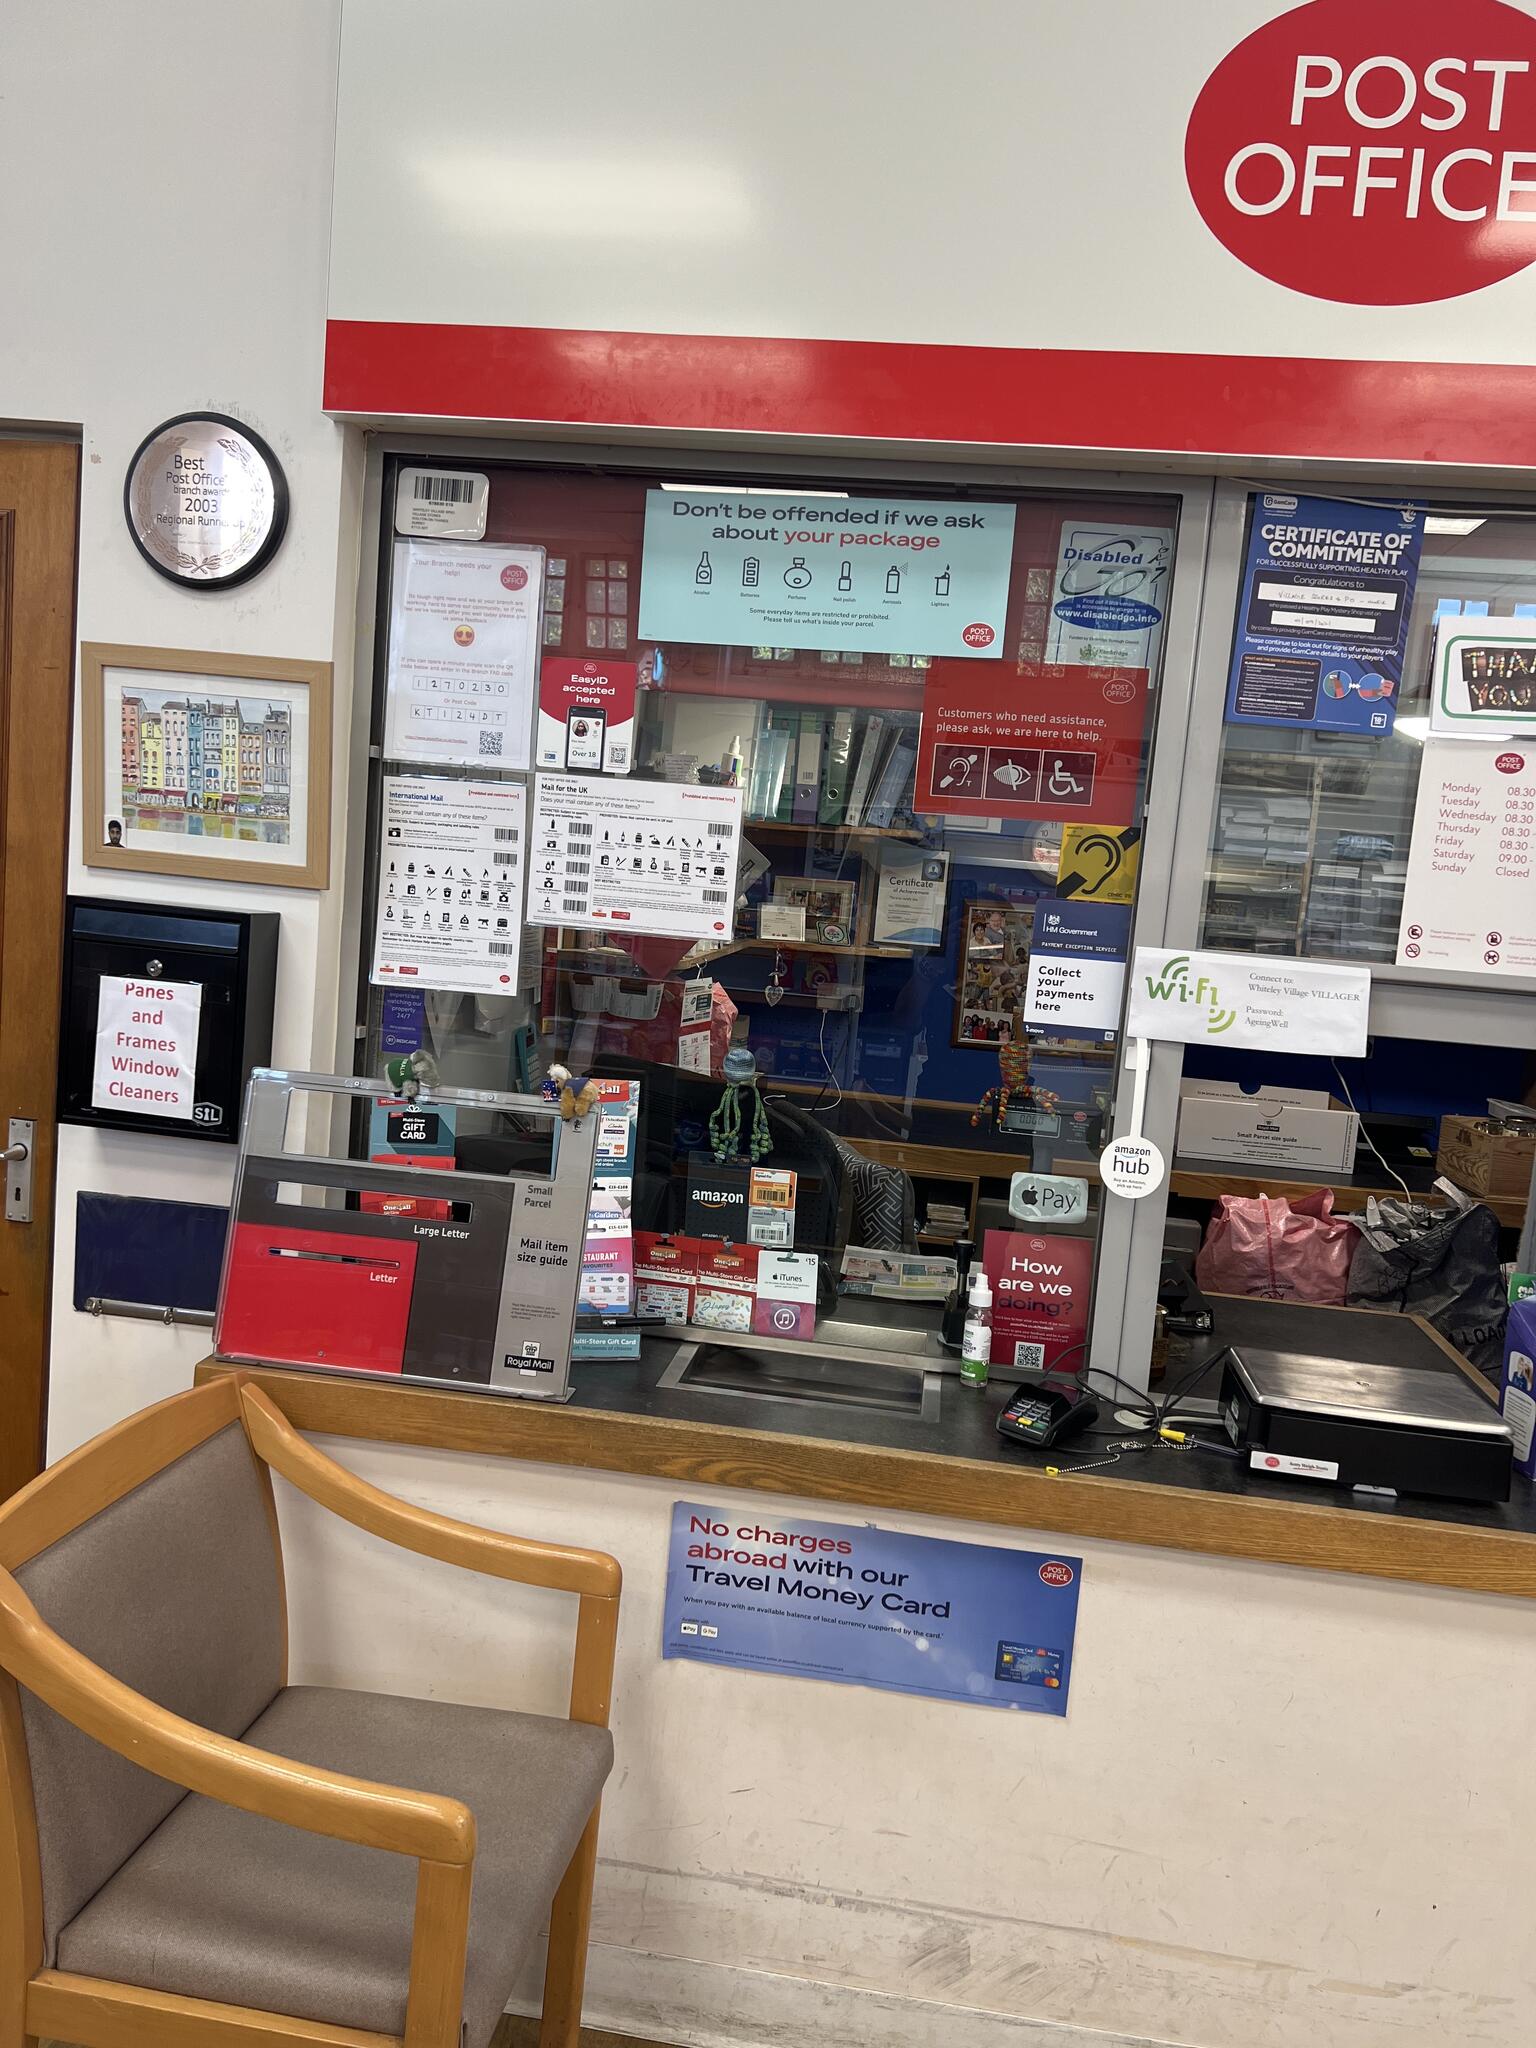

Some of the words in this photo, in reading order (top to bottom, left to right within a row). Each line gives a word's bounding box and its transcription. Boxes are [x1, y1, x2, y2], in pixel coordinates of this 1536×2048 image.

[1290, 55, 1529, 131] POST
[1224, 142, 1536, 222] OFFICE
[174, 454, 205, 470] Best
[166, 472, 189, 485] Post
[192, 473, 225, 486] Office
[174, 486, 200, 496] branch
[202, 487, 228, 496] awar
[184, 498, 218, 513] 2003
[156, 514, 195, 527] Regional
[198, 516, 227, 527] Runn
[673, 501, 732, 518] Don't
[738, 504, 767, 520] be
[772, 506, 879, 525] offended
[884, 510, 900, 525] if
[905, 514, 939, 527] we
[944, 514, 985, 529] ask
[712, 525, 779, 541] about
[784, 530, 835, 545] your
[840, 531, 940, 551] package
[1261, 524, 1382, 547] CERTIFICATE
[1384, 533, 1412, 550] OF
[1064, 548, 1144, 565] Disabled
[1268, 541, 1402, 566] COMMITMENT
[431, 560, 454, 568] Branch
[1270, 559, 1319, 570] SUCCESSFULLY
[1318, 563, 1360, 573] SUPPORTING
[1360, 567, 1392, 576] HEALTHY
[1293, 575, 1356, 589] Congratulations
[1356, 581, 1365, 589] to
[1057, 608, 1158, 623] www.disabledgo.info
[965, 634, 991, 643] OFFICE
[571, 674, 609, 685] EasyID
[562, 685, 616, 696] accepted
[1106, 690, 1132, 698] OFFICE
[1470, 683, 1531, 707] YOU
[576, 694, 601, 704] here
[938, 707, 993, 720] Customers
[996, 712, 1018, 722] who
[1021, 713, 1047, 724] need
[1050, 714, 1107, 728] assistance,
[936, 722, 969, 733] please
[972, 724, 992, 736] ask,
[996, 727, 1011, 737] we
[1014, 728, 1032, 738] are
[1035, 728, 1060, 739] here
[1062, 731, 1074, 740] to
[1076, 730, 1103, 742] help.
[572, 750, 587, 758] Over
[1497, 762, 1521, 770] OFFICE
[556, 784, 565, 792] for
[1442, 782, 1481, 796] Monday
[1507, 787, 1536, 797] 08.30
[389, 791, 429, 801] International
[430, 794, 444, 802] Mail
[1441, 796, 1480, 809] Tuesday
[1506, 800, 1535, 811] 08.30
[1439, 809, 1497, 823] Wednesday
[1505, 814, 1534, 824] 08.30
[1438, 822, 1481, 836] Thursday
[1502, 827, 1530, 838] 08.30
[1435, 835, 1464, 848] Friday
[1500, 840, 1528, 851] 08.30
[1433, 848, 1475, 863] Saturday
[1499, 854, 1528, 865] 09.00
[1432, 861, 1467, 875] Sunday
[1495, 867, 1530, 878] Closed
[889, 877, 934, 889] Certificate
[1046, 926, 1059, 934] HM
[1059, 927, 1098, 937] Government
[1038, 965, 1082, 978] Collect
[1249, 972, 1282, 984] Connect
[1284, 976, 1294, 985] to:
[1037, 977, 1065, 988] your
[125, 982, 175, 1001] Panes
[1036, 988, 1095, 1002] payments
[1248, 983, 1282, 995] Whiteley
[1284, 986, 1309, 998] Village
[1311, 989, 1361, 1002] VILLAGER
[1035, 1001, 1061, 1012] here
[1246, 1006, 1285, 1017] Password:
[132, 1010, 164, 1025] and
[1244, 1017, 1289, 1029] AgeingWell
[116, 1032, 177, 1052] Frames
[111, 1056, 180, 1078] Window
[108, 1082, 179, 1103] Cleaners
[403, 1123, 426, 1132] GIFT
[400, 1131, 427, 1140] CARD
[1283, 1136, 1298, 1144] guide
[1114, 1146, 1151, 1156] amazon
[1113, 1155, 1150, 1175] hub
[528, 1184, 553, 1196] Small
[692, 1190, 744, 1204] amazon
[524, 1197, 552, 1209] Parcel
[1041, 1188, 1077, 1214] Pay
[413, 1225, 440, 1238] Large
[442, 1227, 470, 1240] Letter
[520, 1238, 542, 1250] Mail
[545, 1240, 568, 1253] item
[517, 1252, 537, 1263] size
[540, 1255, 568, 1267] guide
[583, 1252, 619, 1262] STAURANT
[643, 1263, 671, 1273] Multi-Store
[1011, 1257, 1063, 1276] How
[370, 1272, 398, 1284] Letter
[706, 1270, 733, 1280] Multi-Store
[780, 1274, 803, 1283] iTunes
[998, 1278, 1034, 1292] are
[1039, 1282, 1073, 1296] we
[998, 1295, 1074, 1317] doing?
[507, 1357, 532, 1368] Royal
[532, 1360, 552, 1370] Mail
[690, 1515, 730, 1537] No
[736, 1525, 853, 1555] charges
[687, 1542, 787, 1570] abroad
[792, 1558, 853, 1580] with
[860, 1569, 909, 1587] our
[1047, 1566, 1067, 1574] POST
[1042, 1572, 1069, 1582] OFFICE
[686, 1564, 770, 1593] Travel
[777, 1577, 875, 1611] Money
[881, 1593, 951, 1619] Card
